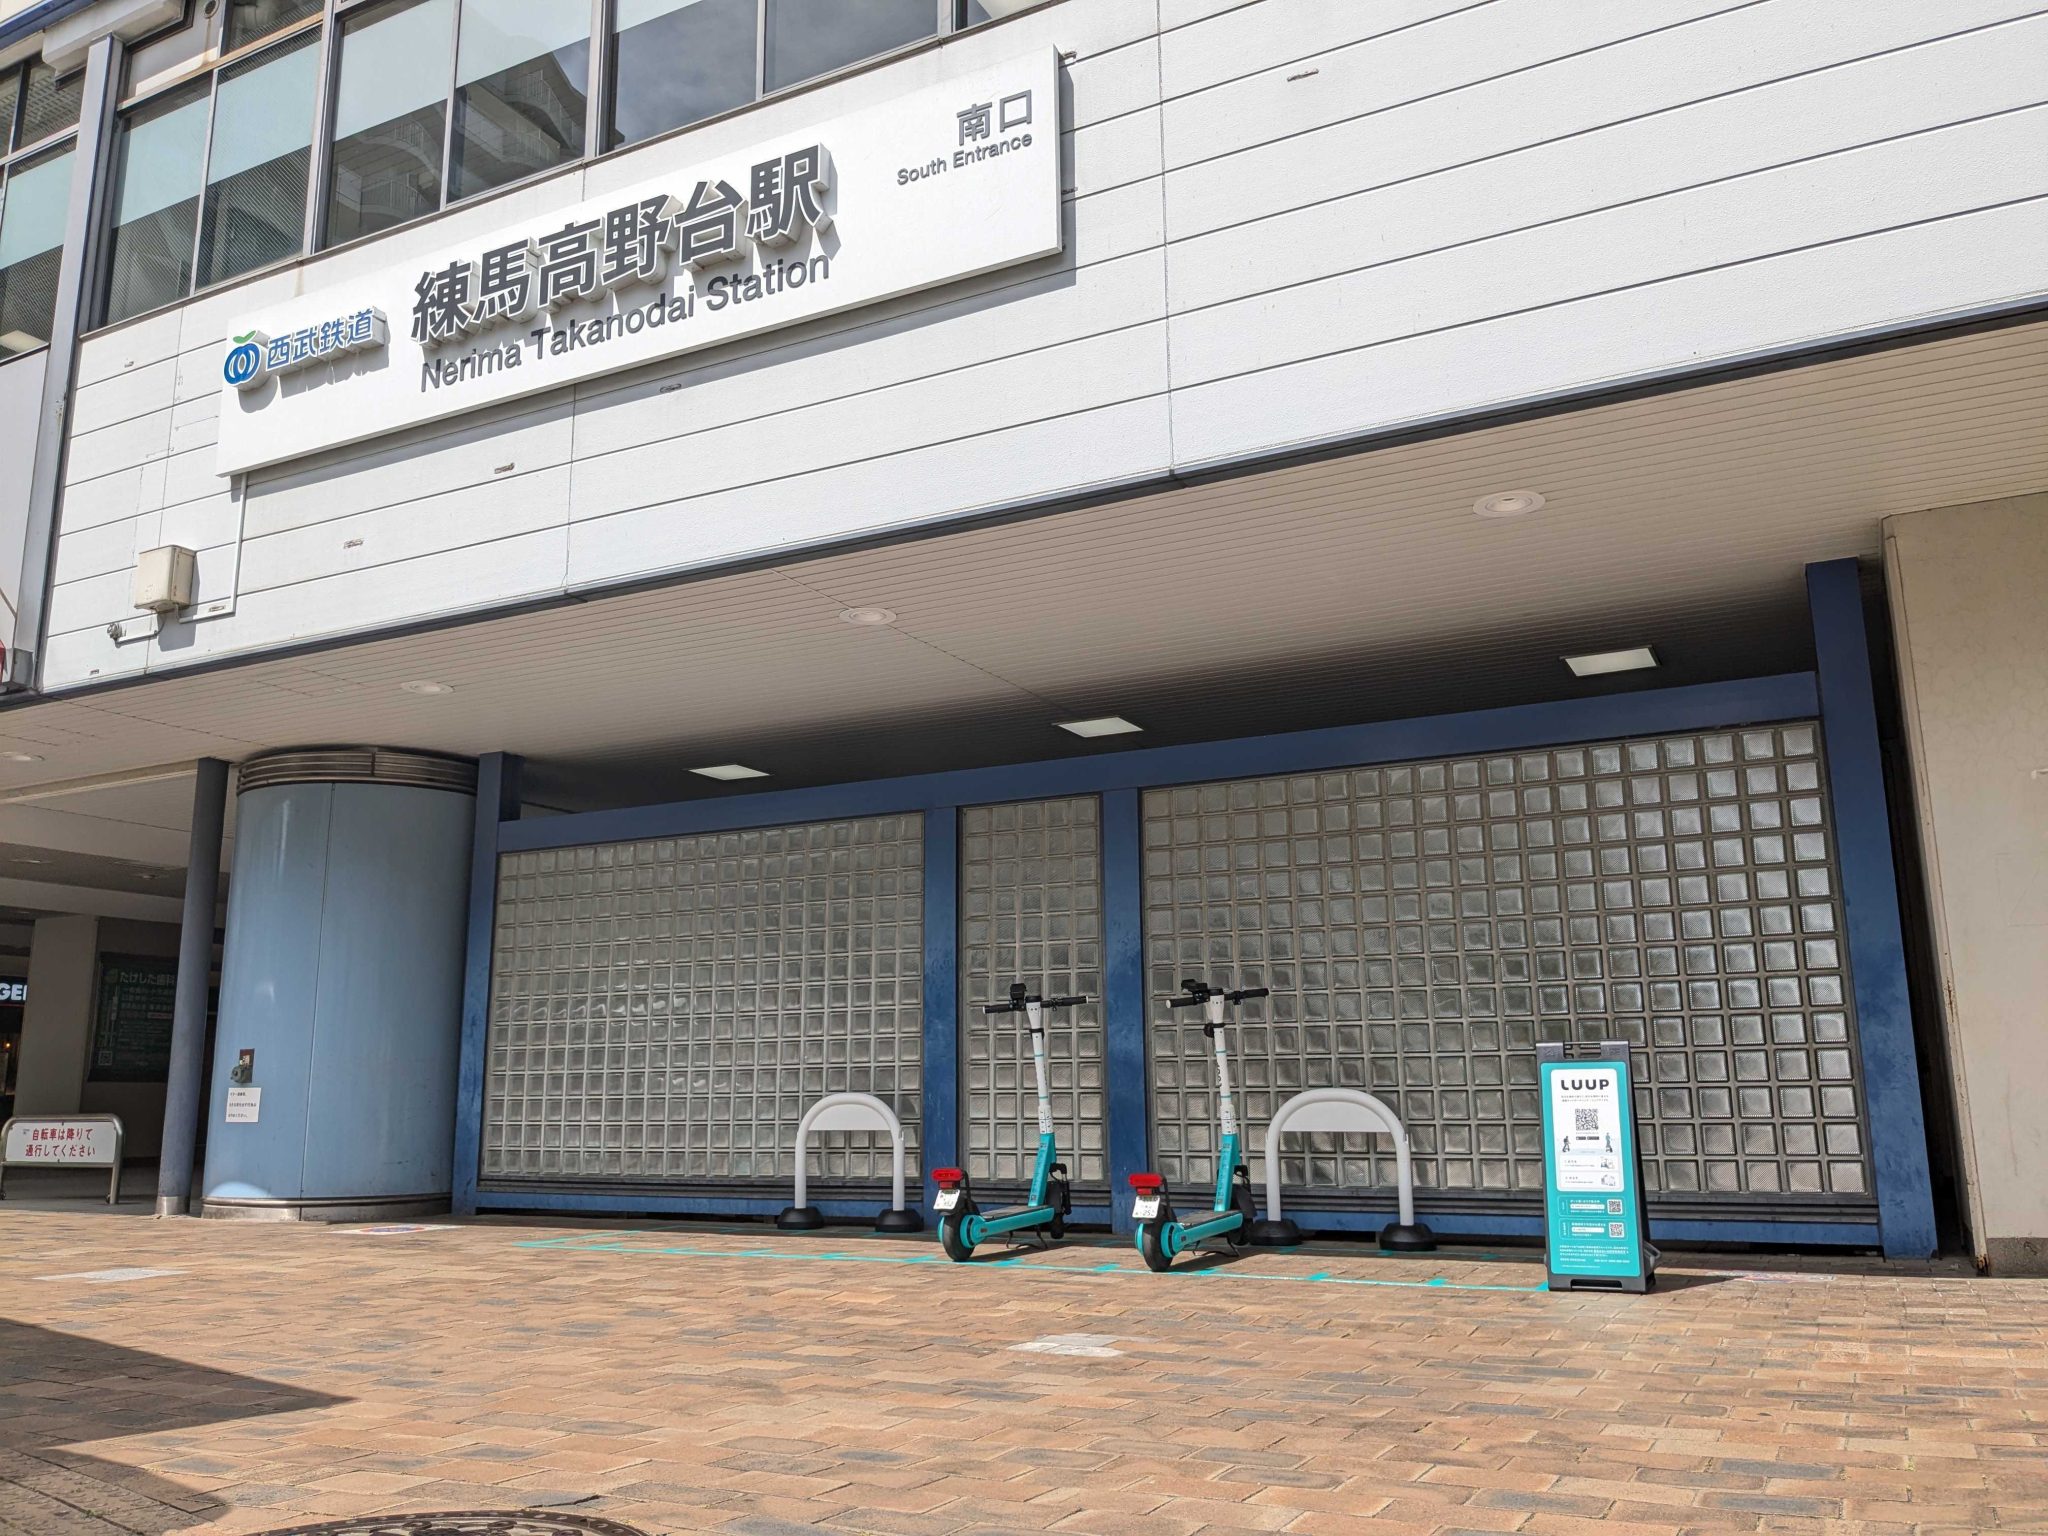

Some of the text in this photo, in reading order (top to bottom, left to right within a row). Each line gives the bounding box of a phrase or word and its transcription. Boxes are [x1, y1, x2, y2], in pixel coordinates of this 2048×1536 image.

[957, 89, 1032, 146] 南口
[897, 133, 1032, 186] South Entrance
[410, 144, 824, 344] 練馬高野台駅
[266, 308, 374, 371] 西武鉄道
[421, 254, 830, 392] Nerima Takanodai Station
[1561, 1079, 1609, 1091] LUUP
[25, 1144, 96, 1158] 通行してください
[32, 1128, 93, 1141] 自転車は降りて
